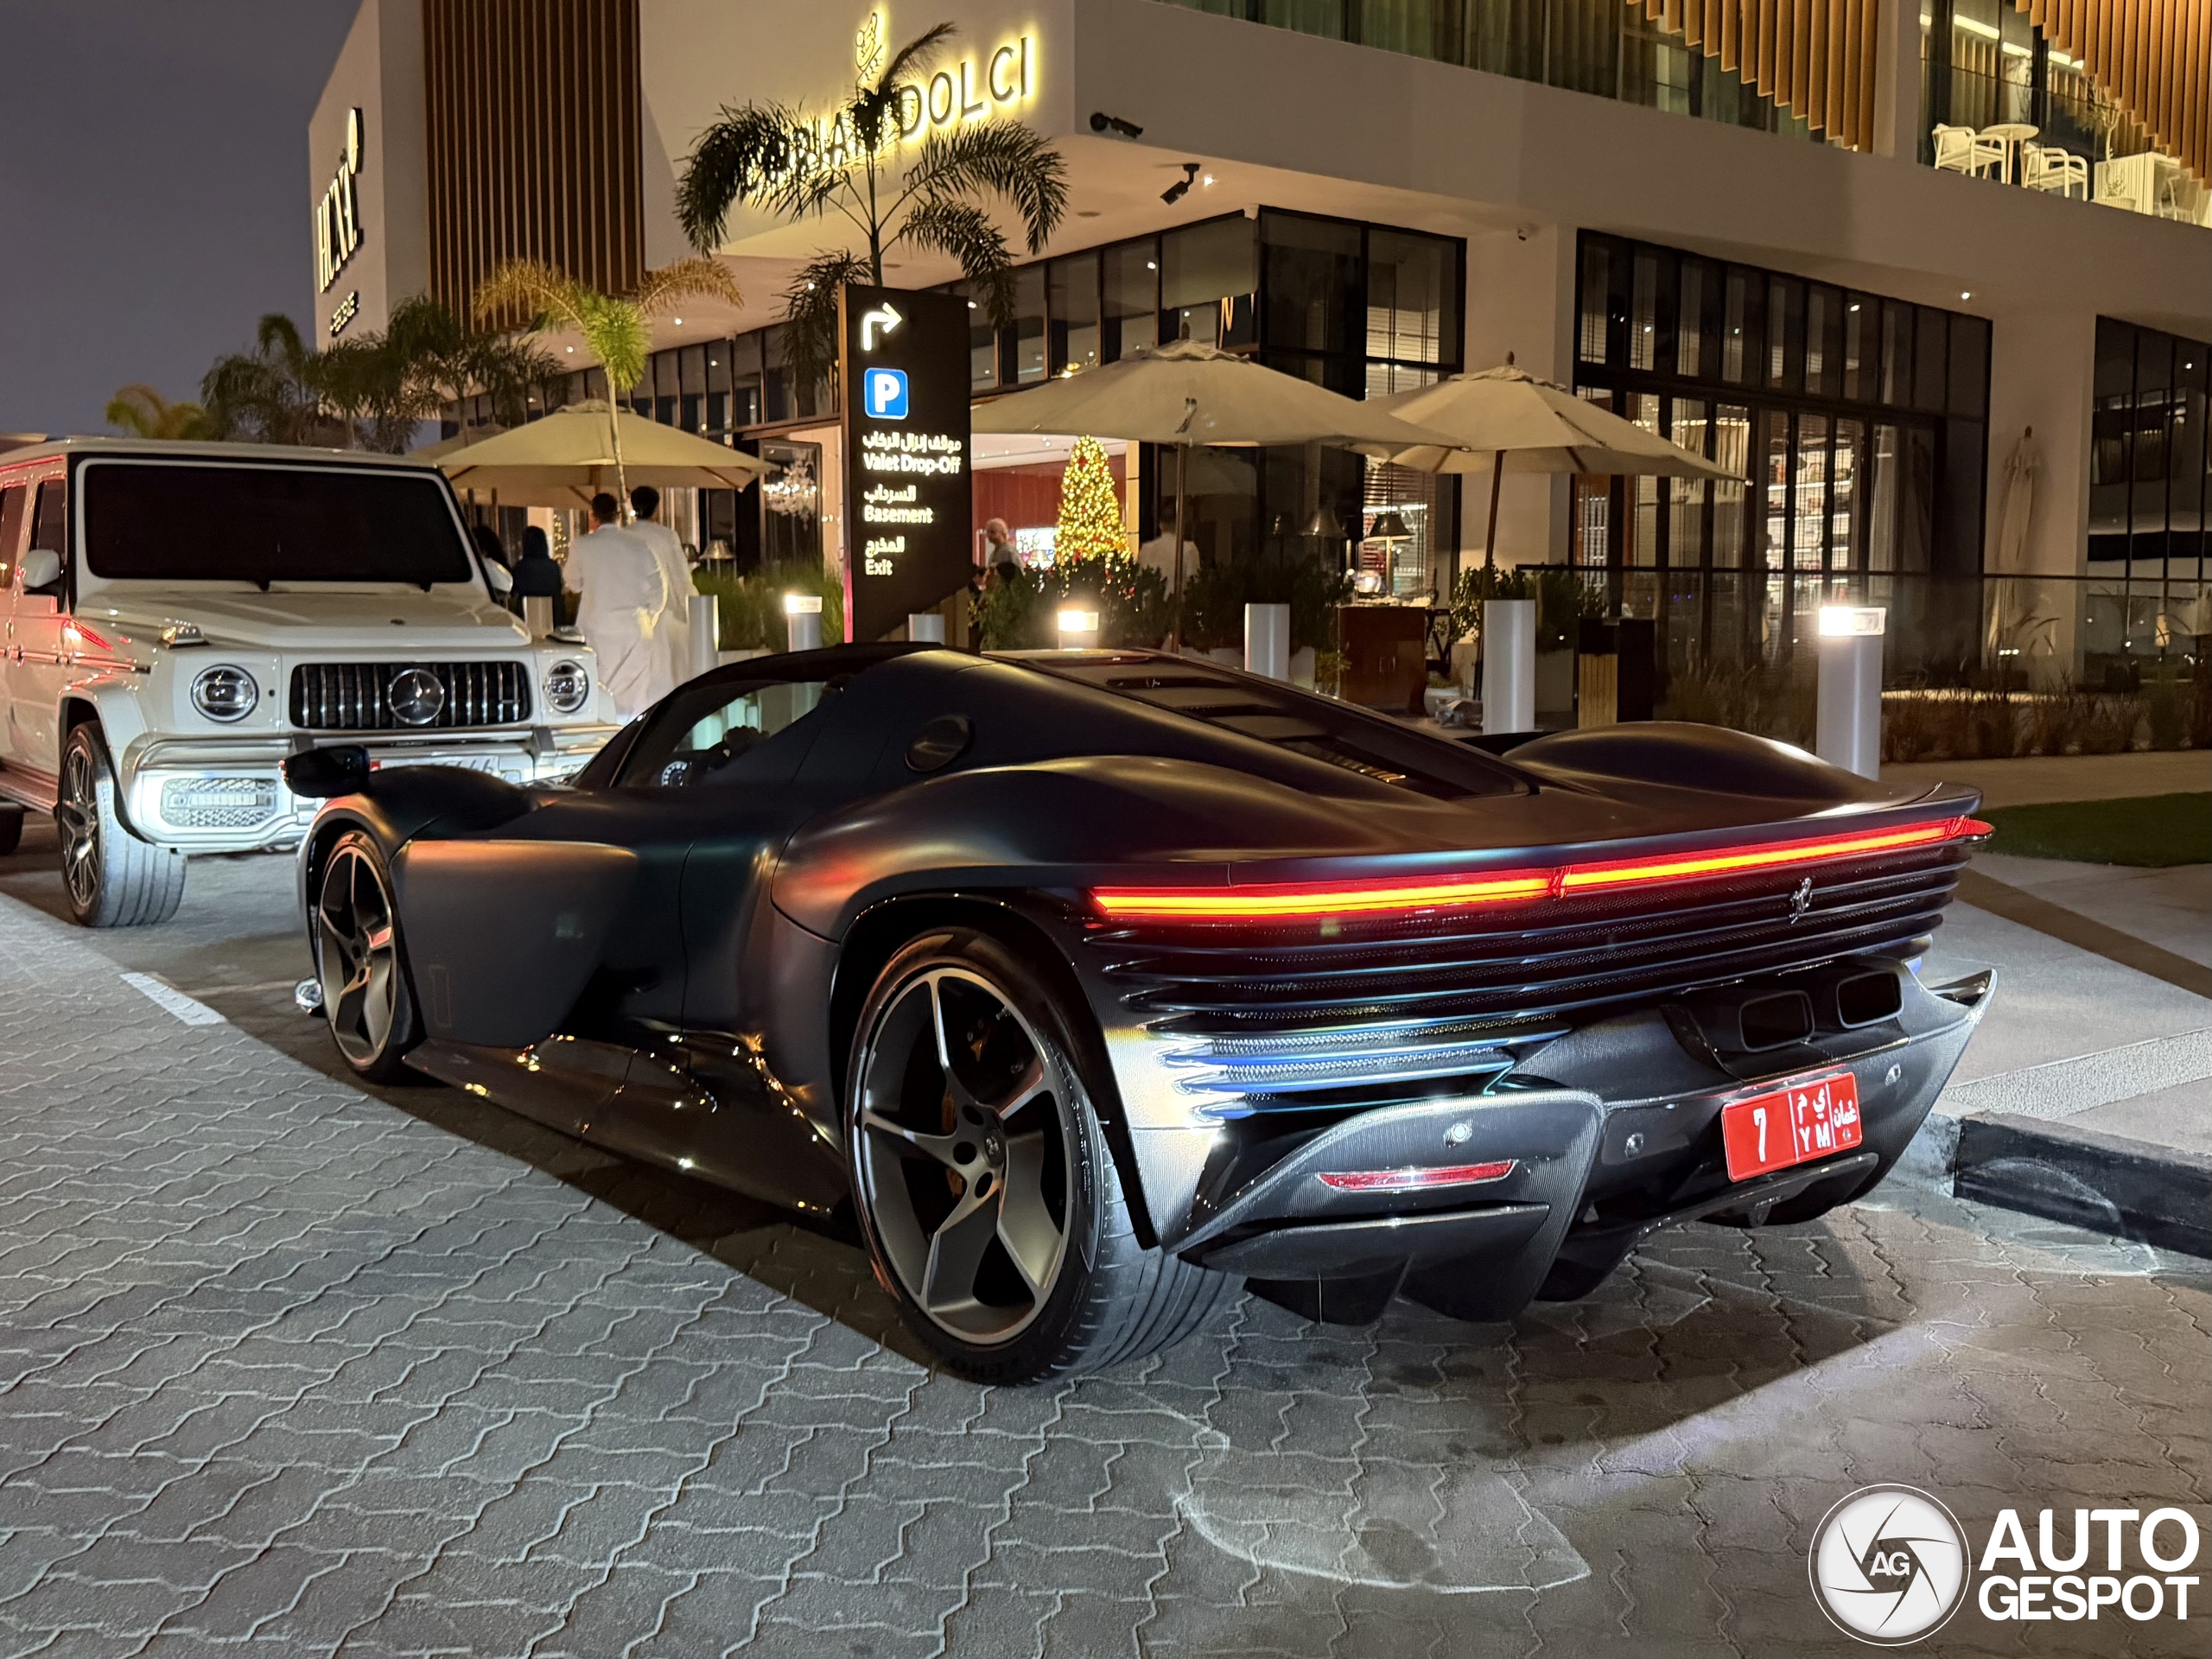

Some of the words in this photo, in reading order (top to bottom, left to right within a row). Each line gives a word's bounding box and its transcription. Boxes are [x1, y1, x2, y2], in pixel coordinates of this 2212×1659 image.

[899, 37, 1027, 139] DOLCI
[874, 374, 900, 413] P
[862, 430, 900, 451] الركاب
[928, 434, 962, 454] موقف
[863, 452, 899, 472] Valet
[900, 454, 962, 476] Drop-Off
[863, 483, 917, 504] السرداب
[864, 505, 933, 524] Basement
[865, 536, 906, 558] المخرج
[865, 558, 893, 576] Exit
[1752, 1107, 1767, 1162] 7
